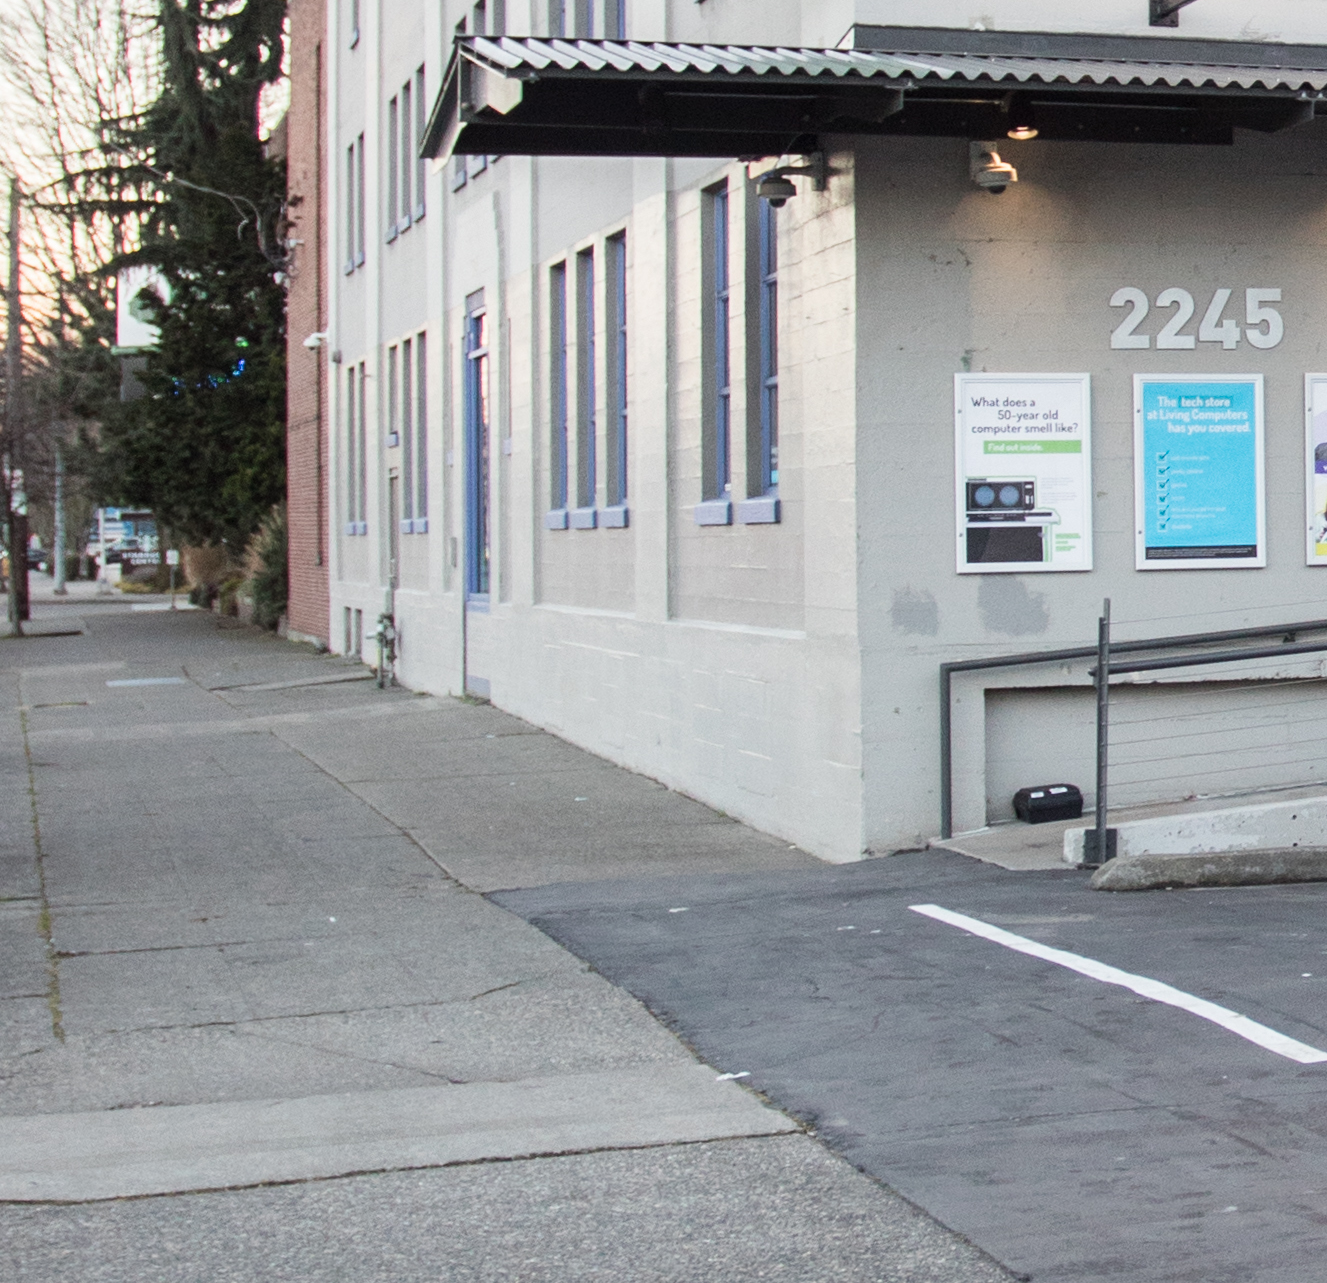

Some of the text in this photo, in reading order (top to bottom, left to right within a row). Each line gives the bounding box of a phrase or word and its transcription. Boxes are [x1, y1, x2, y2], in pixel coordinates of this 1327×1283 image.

[1109, 286, 1284, 350] 2245
[971, 397, 1036, 407] What does a
[1157, 396, 1231, 407] The tech store
[997, 410, 1059, 422] 50-year old
[1147, 409, 1248, 422] at Living Computers
[971, 423, 1078, 435] computer smell like?
[1167, 421, 1251, 435] has you covered.
[988, 442, 1004, 451] Find
[1006, 443, 1018, 451] out
